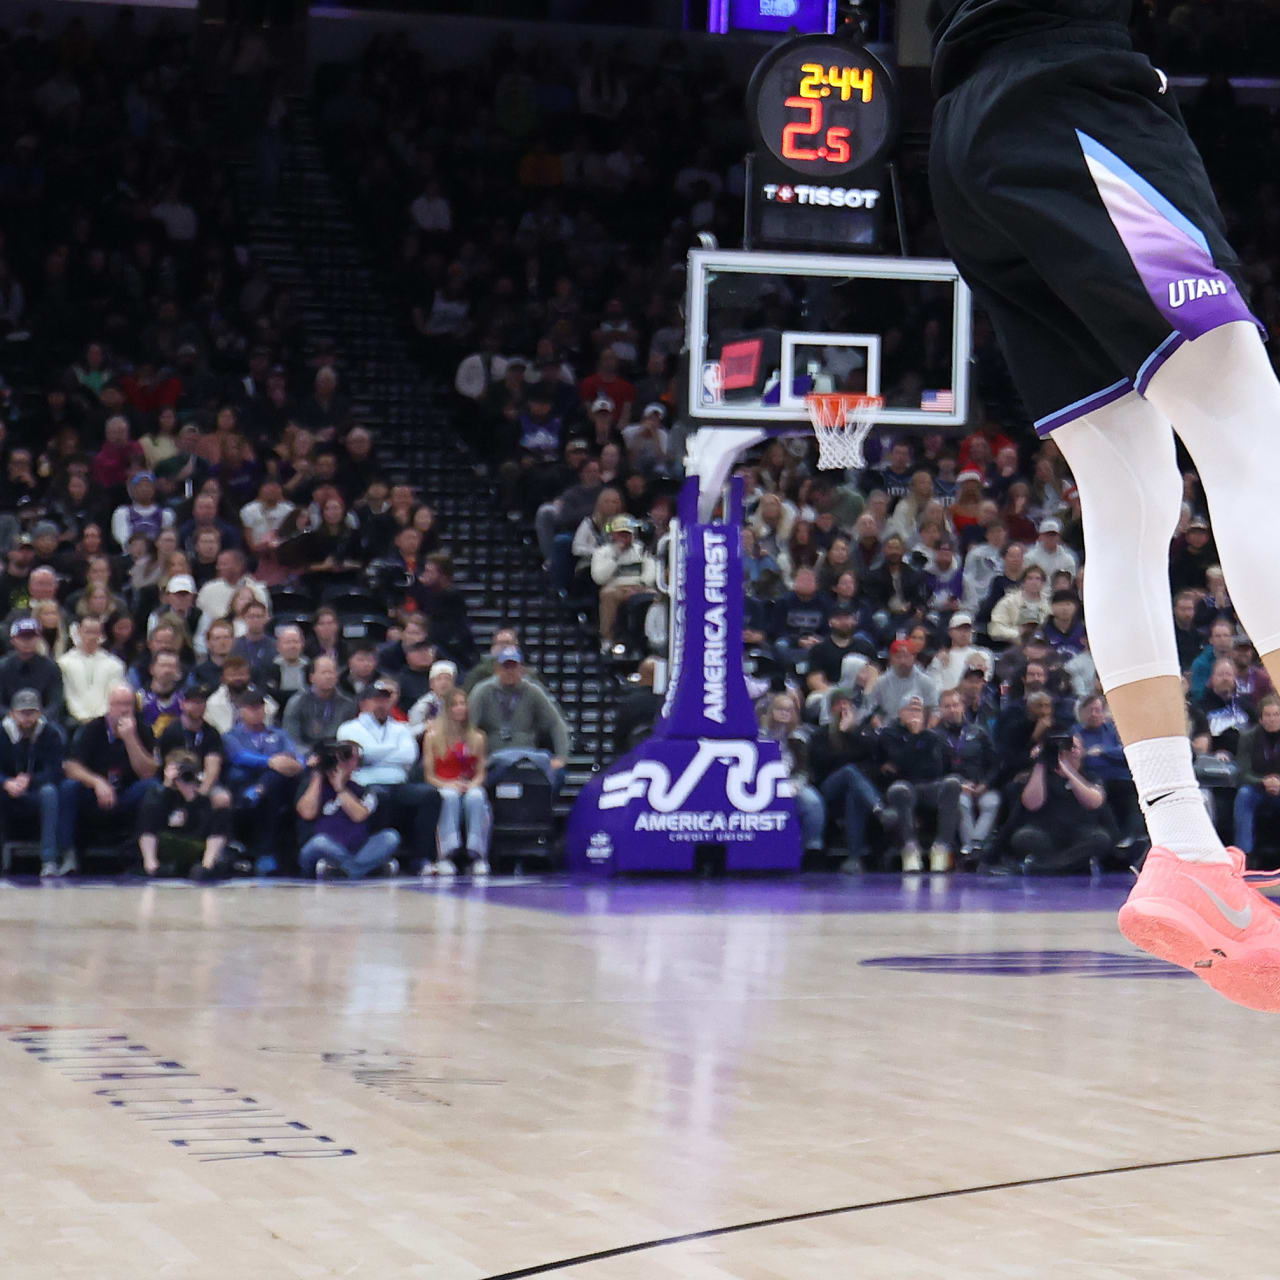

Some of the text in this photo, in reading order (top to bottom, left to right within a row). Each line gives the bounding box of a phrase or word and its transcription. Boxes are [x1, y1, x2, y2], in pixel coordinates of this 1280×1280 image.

[799, 63, 873, 103] 2:44
[782, 96, 851, 163] 2.5
[794, 184, 880, 209] TISSOT
[1167, 278, 1227, 309] UTAH
[703, 527, 728, 724] AMERICA FIRST
[634, 811, 790, 832] AMERICA FIRST
